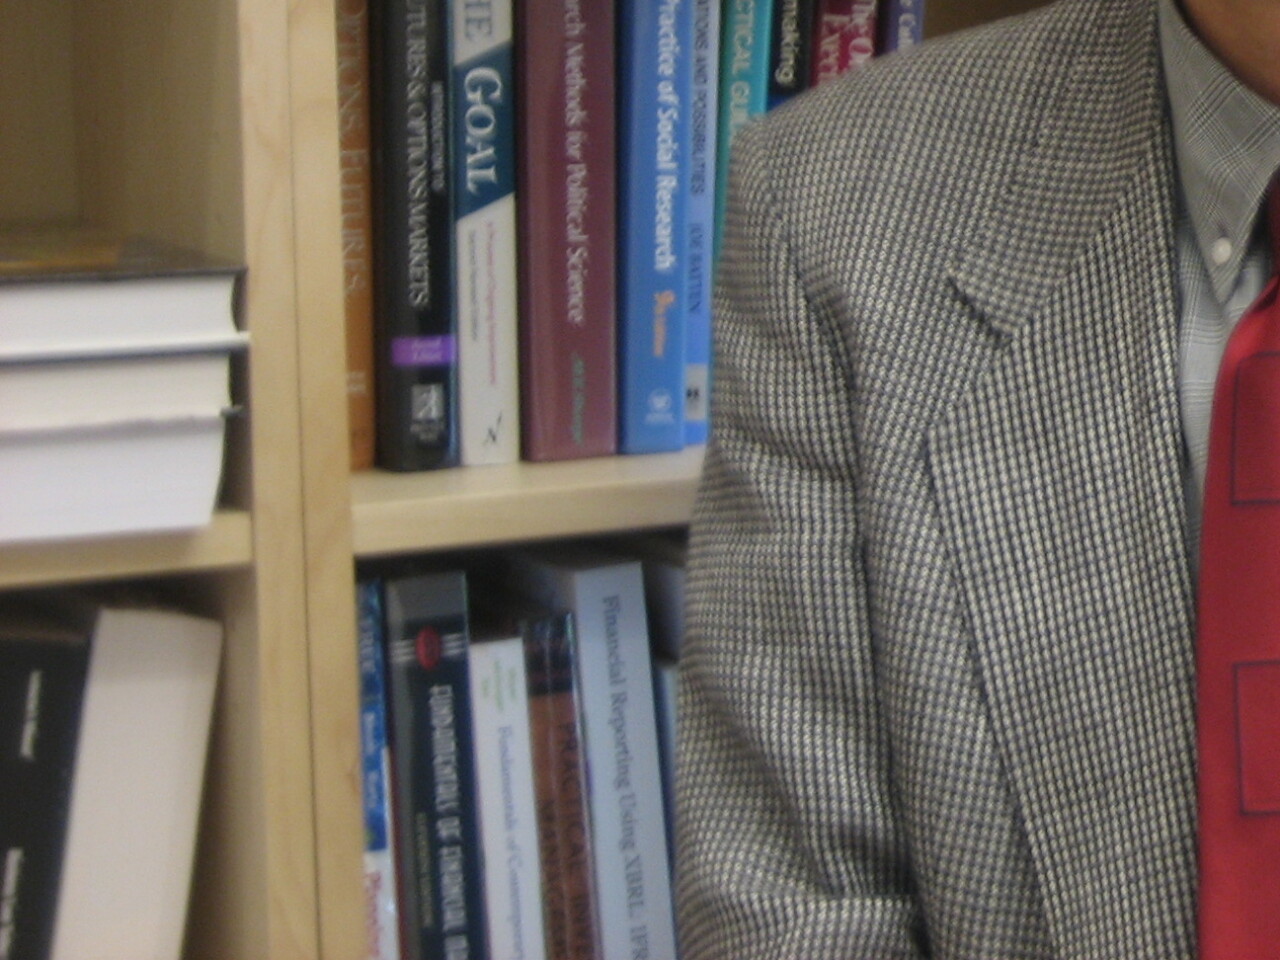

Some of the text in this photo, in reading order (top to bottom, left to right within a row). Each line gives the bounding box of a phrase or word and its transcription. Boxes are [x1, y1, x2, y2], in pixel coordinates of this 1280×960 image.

[818, 12, 849, 87] Exec
[896, 12, 917, 51] Cul
[406, 81, 428, 98] &
[565, 42, 587, 126] Methods
[658, 80, 681, 106] of
[406, 101, 430, 203] OPTIONS
[464, 67, 502, 196] GOAL
[565, 130, 586, 160] for
[656, 109, 680, 170] Social
[565, 163, 587, 239] Political
[654, 174, 678, 270] Research
[407, 203, 430, 307] MARKETS
[565, 245, 588, 325] Science
[600, 593, 628, 686] Financial
[430, 684, 459, 813] FUNDAMENTALS
[609, 690, 639, 791] Reporting
[435, 815, 462, 841] OF
[617, 792, 644, 853] Using
[439, 844, 465, 933] FINANCIAL
[572, 895, 597, 960] INVE
